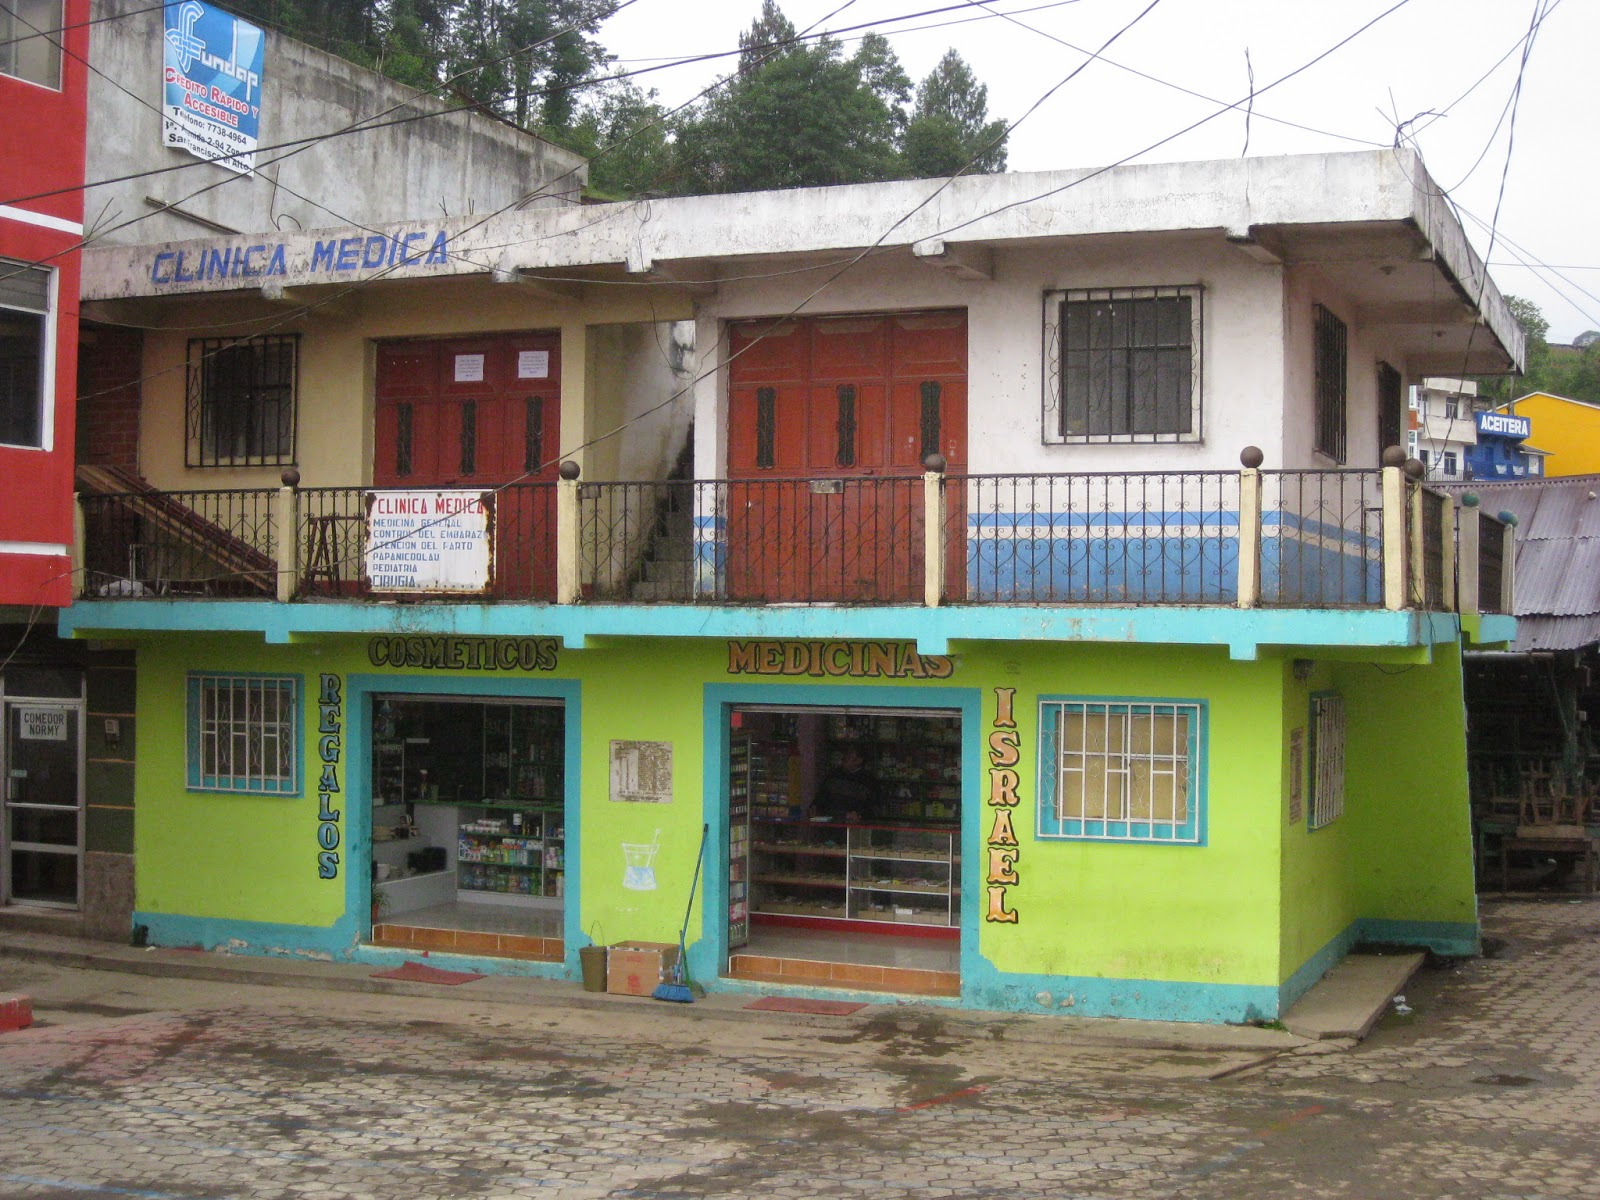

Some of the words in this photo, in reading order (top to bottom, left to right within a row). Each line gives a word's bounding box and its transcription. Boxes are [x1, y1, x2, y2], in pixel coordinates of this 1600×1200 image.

[184, 93, 238, 126] ACCESIBLE
[151, 243, 288, 284] CLINICA
[310, 230, 448, 273] MEDICA
[1481, 415, 1528, 436] ACEITERA
[378, 498, 427, 514] CLINICA
[435, 498, 484, 514] MEDICA
[373, 519, 415, 527] MEDICINA
[421, 519, 462, 528] GENERAL
[373, 529, 414, 538] CONTROL
[418, 530, 436, 539] DEL
[373, 541, 417, 549] ATENCION
[421, 541, 438, 550] DEL
[372, 564, 418, 572] PEDIATRIA
[372, 575, 416, 588] CIRUGIA
[368, 636, 558, 671] COSMETICOS
[727, 640, 954, 679] MEDICINAS
[24, 712, 65, 725] COMEDOR
[29, 725, 60, 736] NORMY
[318, 673, 341, 879] REGALOS
[986, 688, 1021, 924] ISRAEL
